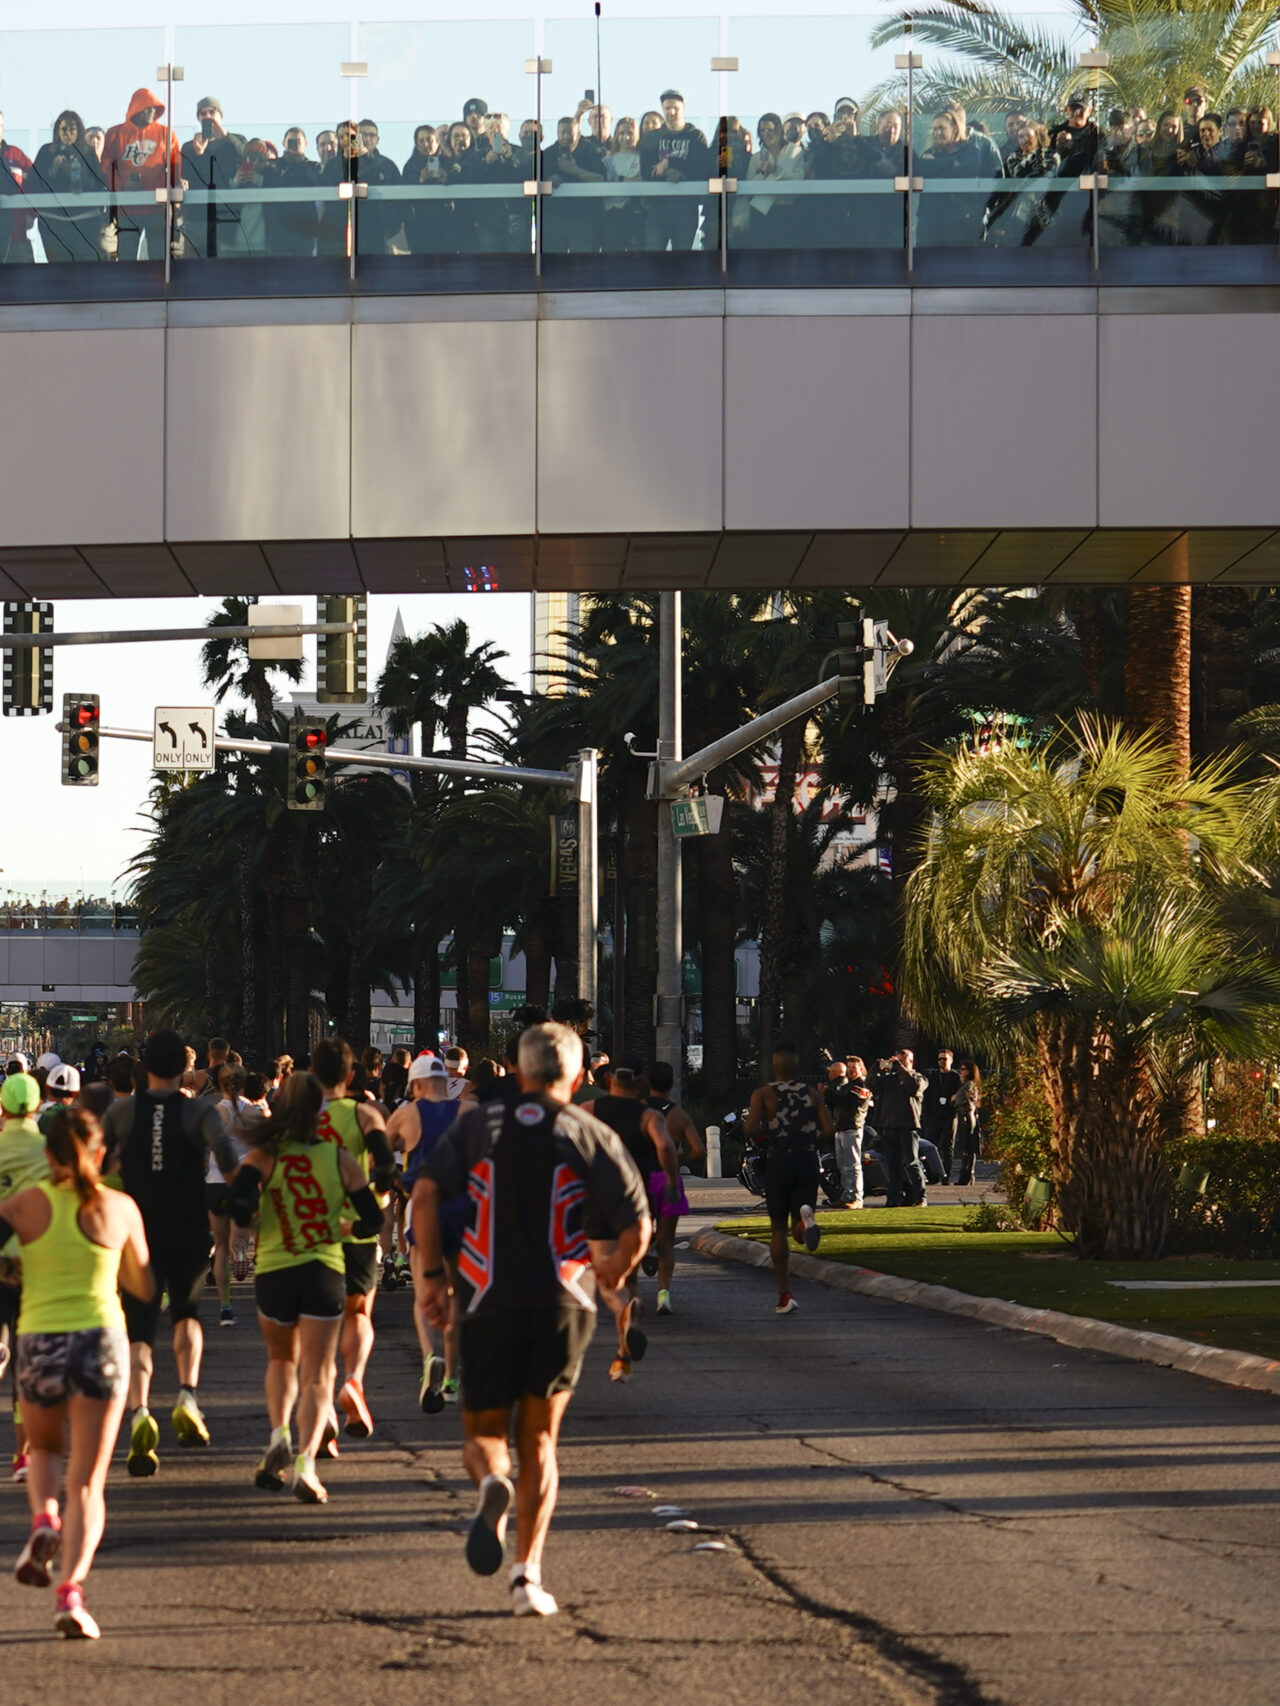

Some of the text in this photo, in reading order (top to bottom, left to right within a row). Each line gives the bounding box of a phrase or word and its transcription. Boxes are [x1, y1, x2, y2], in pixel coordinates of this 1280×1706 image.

[156, 753, 182, 763] ONLY
[185, 753, 211, 763] ONLY
[559, 837, 578, 884] VEGAS
[491, 992, 500, 1001] 15
